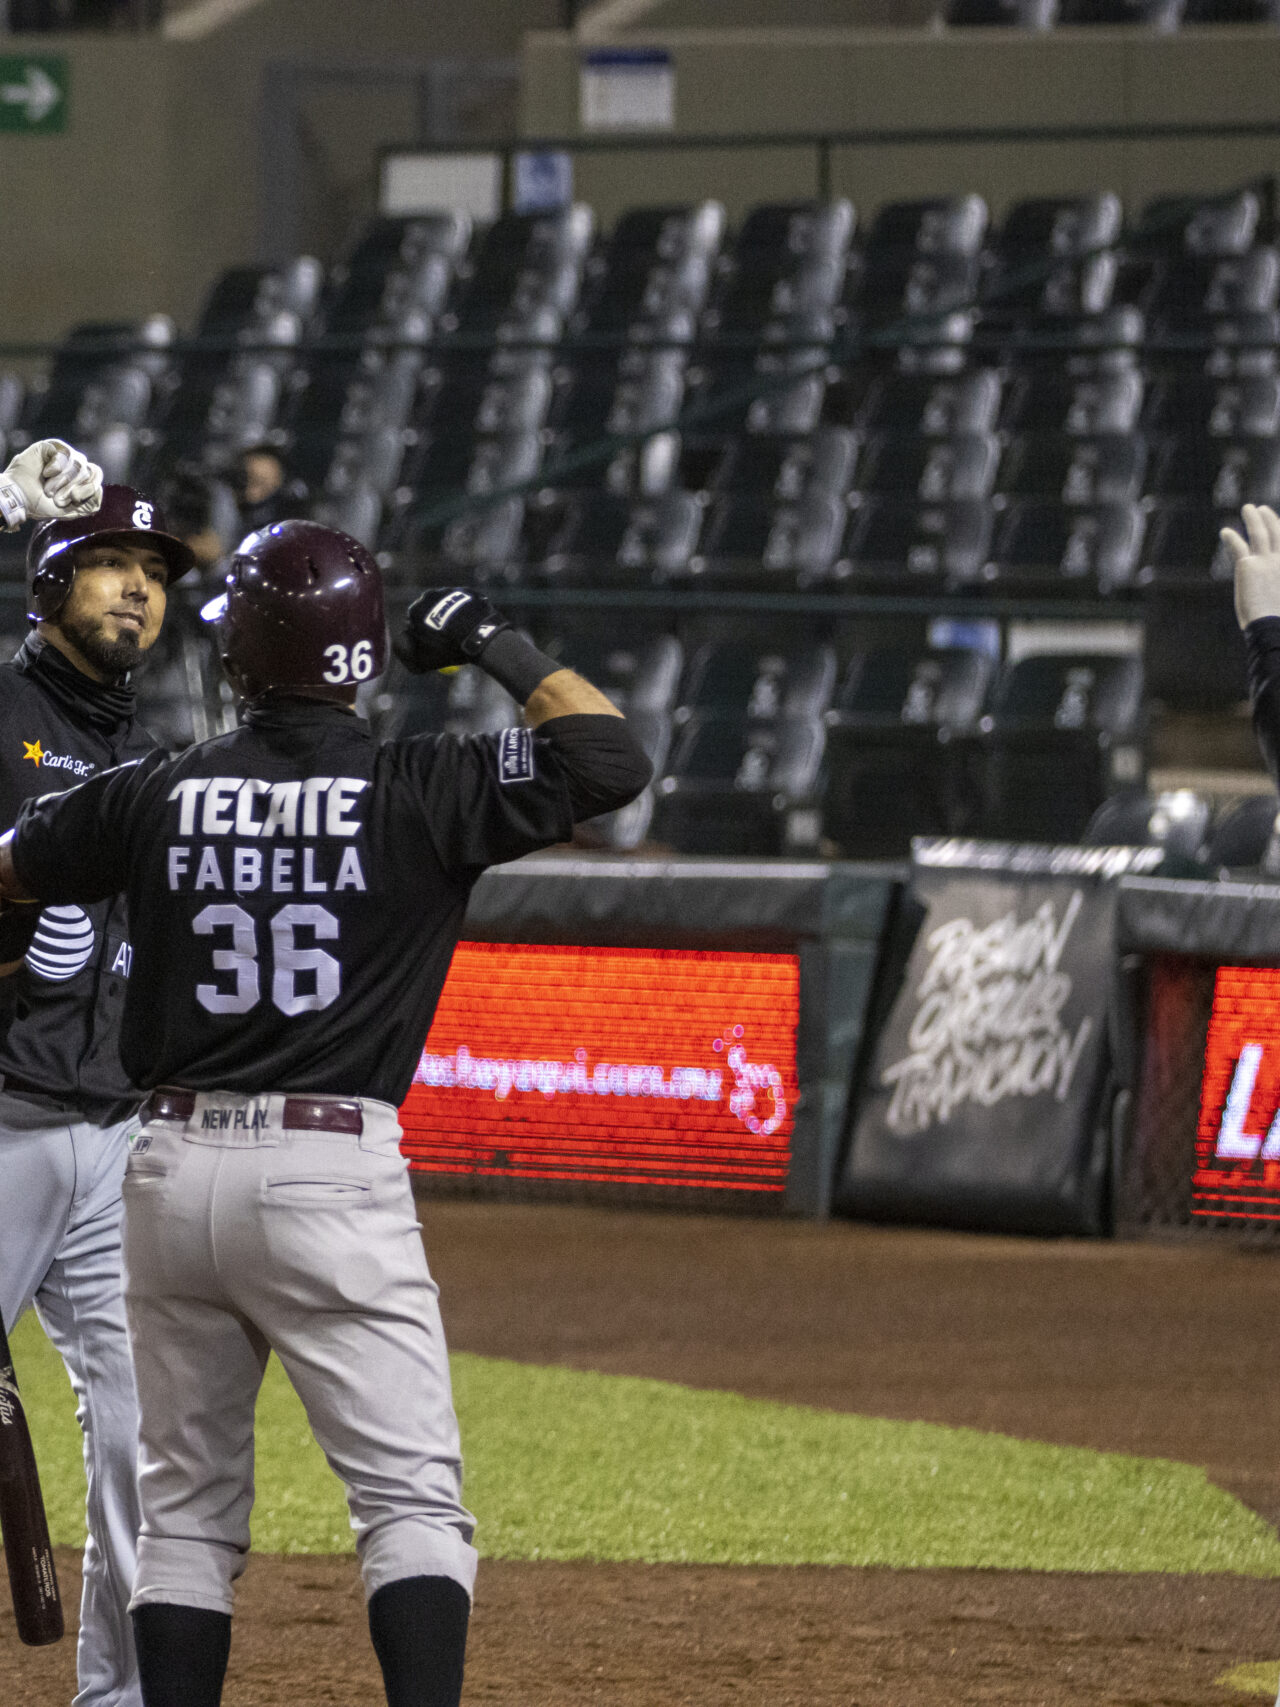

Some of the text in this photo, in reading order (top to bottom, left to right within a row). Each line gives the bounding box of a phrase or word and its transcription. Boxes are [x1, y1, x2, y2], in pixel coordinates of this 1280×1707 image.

[323, 640, 372, 683] 36
[42, 750, 74, 770] Carl's
[168, 777, 372, 837] TECATE
[168, 846, 366, 892] FABELA
[192, 904, 340, 1016] 36
[201, 1109, 232, 1129] NEW
